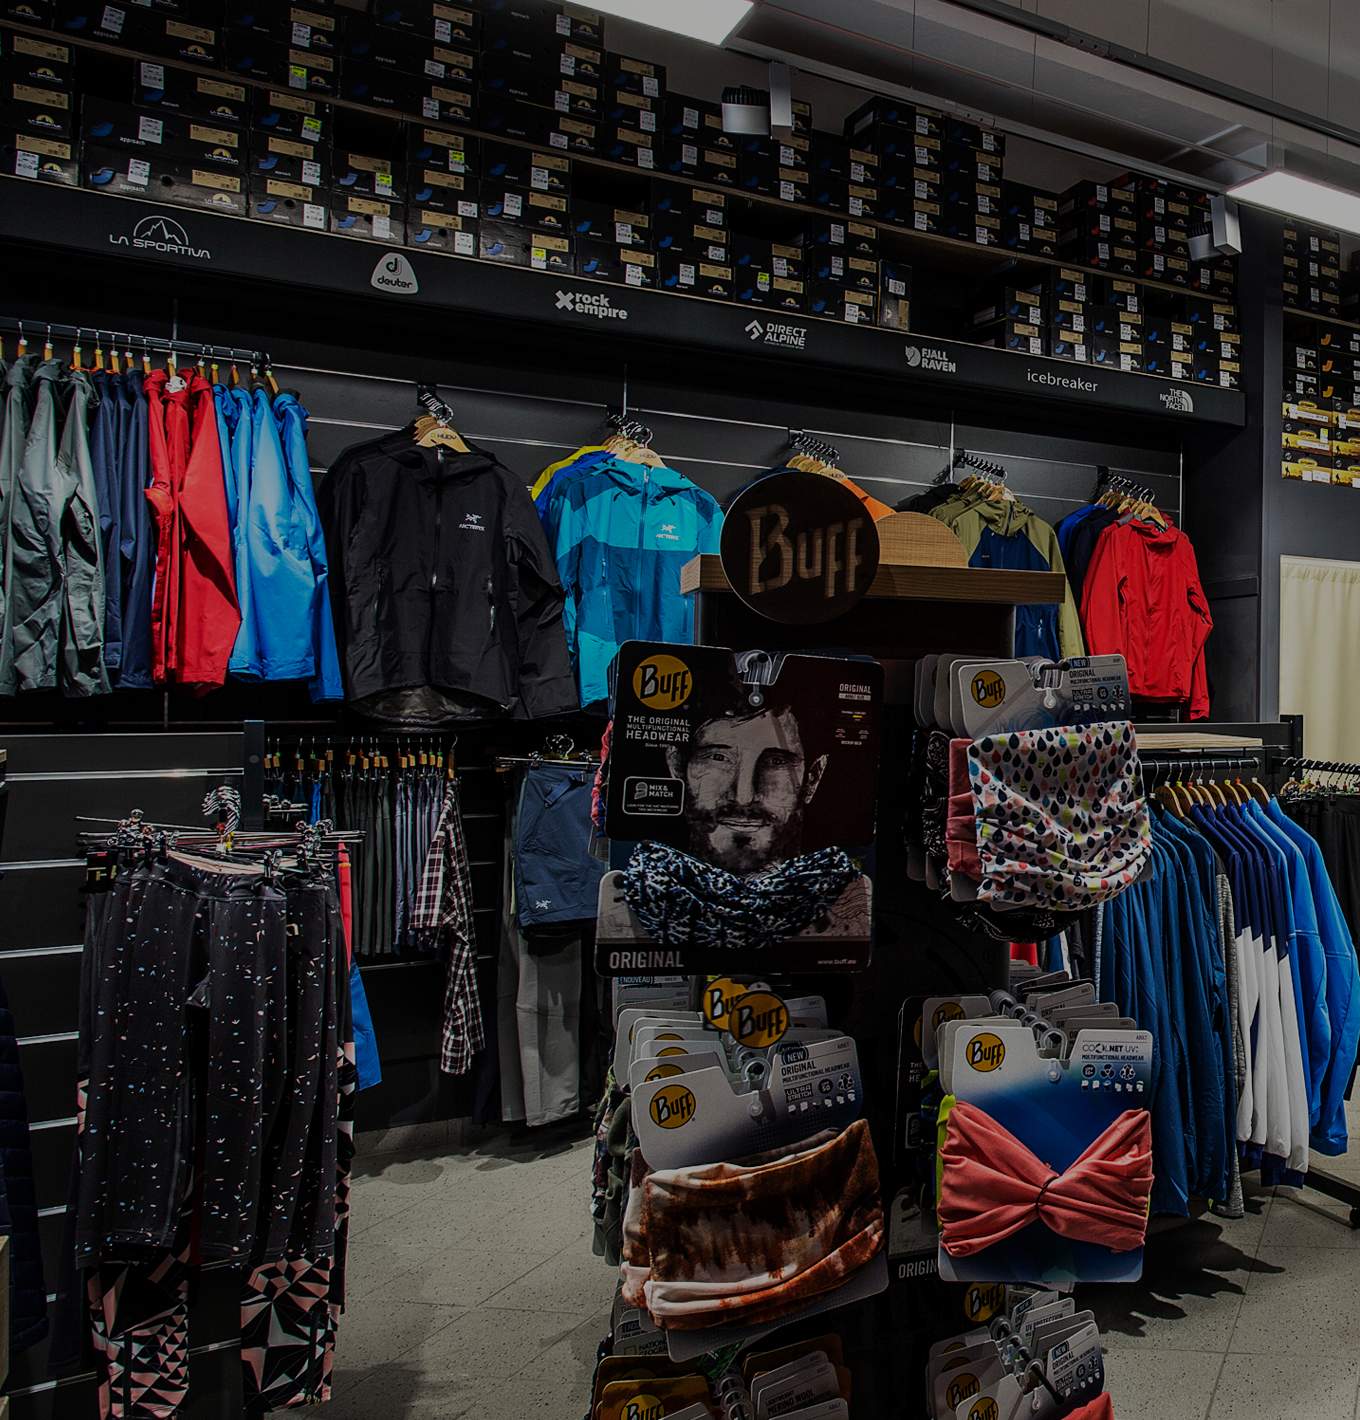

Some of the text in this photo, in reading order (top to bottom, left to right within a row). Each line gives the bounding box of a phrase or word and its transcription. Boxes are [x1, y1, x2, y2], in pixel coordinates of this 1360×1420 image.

[109, 233, 211, 259] LA SPORTIVA
[377, 275, 413, 289] deuter
[574, 291, 610, 308] rock
[574, 301, 628, 320] empire
[765, 322, 808, 338] DIRECT
[764, 333, 806, 346] ALPINE
[1026, 368, 1098, 392] icebreaker
[1169, 388, 1183, 398] THE
[1069, 669, 1096, 678] ORIGINAL
[839, 683, 872, 694] ORIGINAL
[626, 723, 690, 733] MULTIFUNCTIONAL
[627, 715, 691, 727] THE ORIGINAL
[626, 730, 690, 743] HEADWEAR
[609, 950, 685, 970] ORIGINAL
[785, 1051, 804, 1063] NEW
[781, 1060, 817, 1076] ORIGINAL
[898, 1259, 938, 1279] ORIGIN
